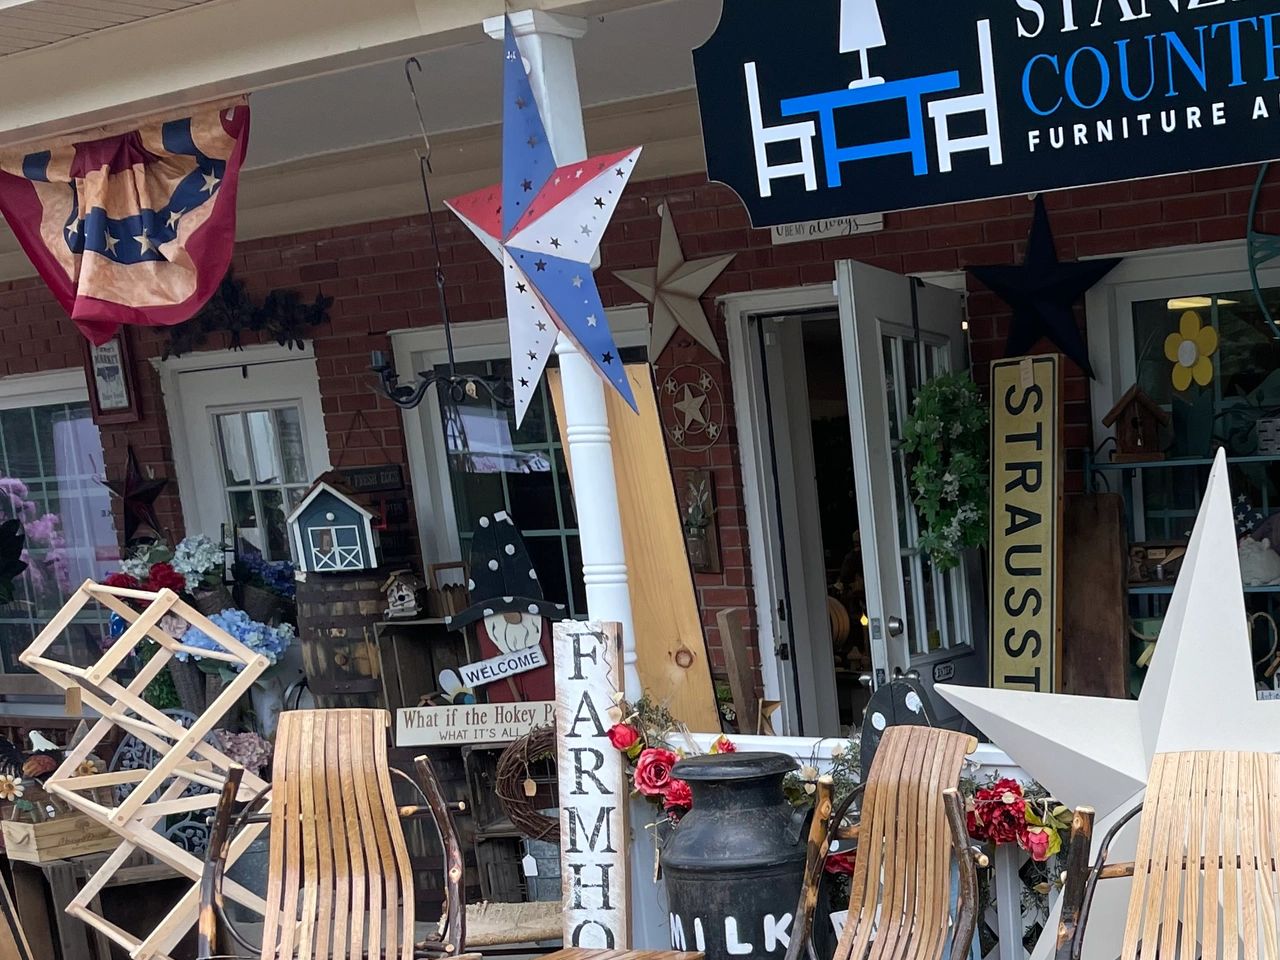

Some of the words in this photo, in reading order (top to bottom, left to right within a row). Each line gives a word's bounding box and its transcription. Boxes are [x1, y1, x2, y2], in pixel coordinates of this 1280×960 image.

[1028, 102, 1226, 152] FURNITURE
[1003, 384, 1043, 692] STRAUSST
[466, 652, 541, 683] WELCOME
[403, 709, 440, 729] What
[446, 708, 458, 727] if
[466, 705, 488, 726] the
[494, 702, 536, 726] Hokey
[439, 728, 468, 741] WHAT
[474, 727, 496, 740] IT'S
[501, 726, 522, 738] ALL
[670, 912, 792, 955] MILK
